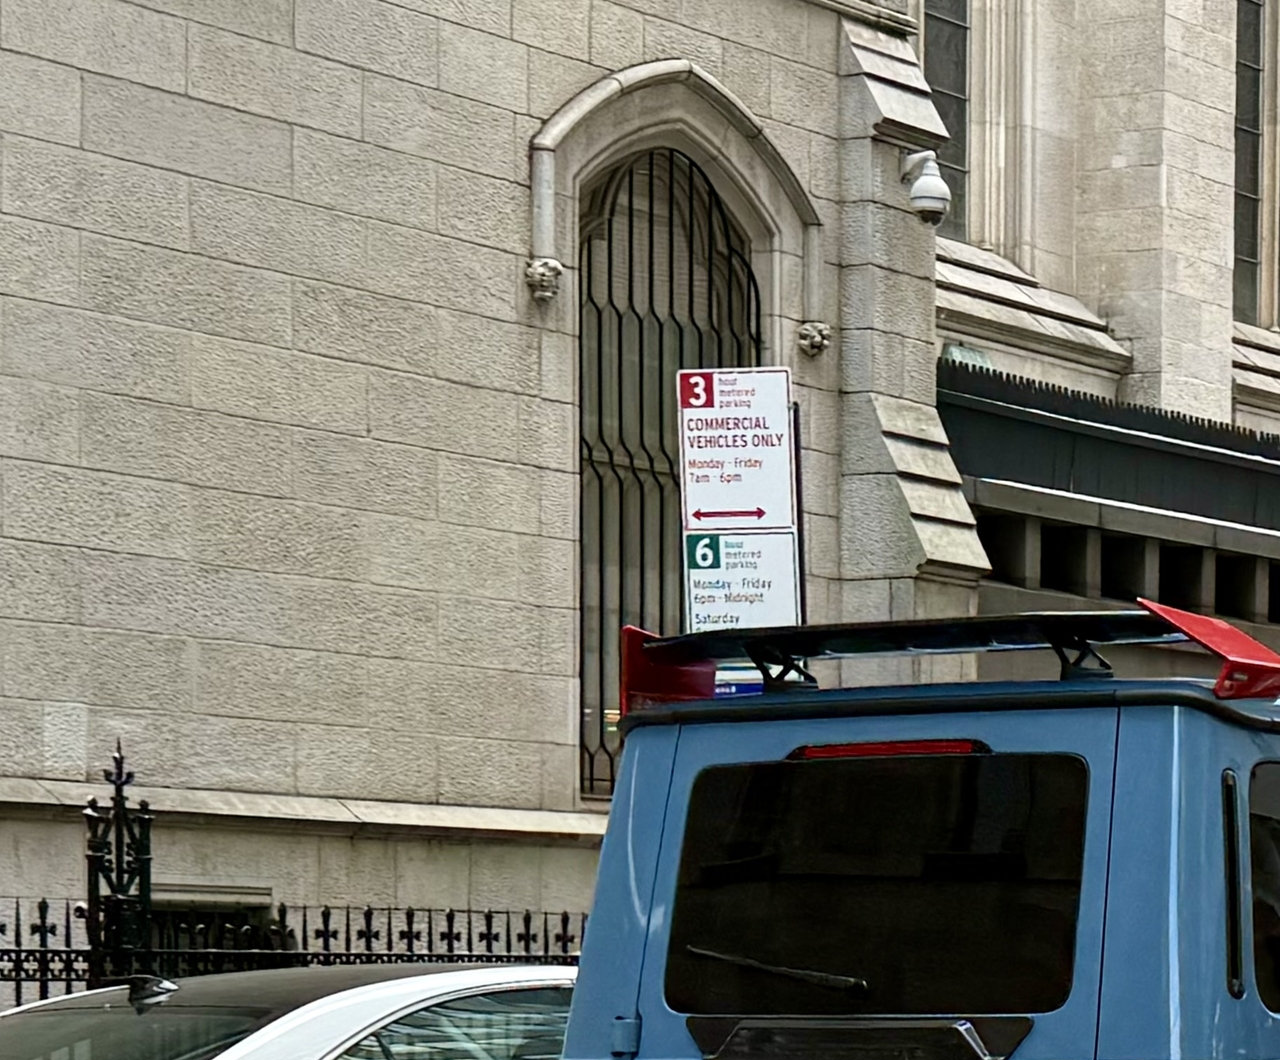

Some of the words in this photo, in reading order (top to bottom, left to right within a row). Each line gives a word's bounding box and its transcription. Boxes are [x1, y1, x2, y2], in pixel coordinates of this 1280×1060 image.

[688, 375, 707, 407] 3
[719, 399, 752, 409] parking
[687, 416, 770, 432] COMMERCIAL
[687, 434, 748, 449] VEHICLES
[752, 433, 784, 448] ONLY
[688, 458, 725, 470] Monday
[734, 457, 763, 470] Friday
[720, 472, 743, 484] 6pm
[695, 537, 714, 568] 6
[693, 579, 732, 591] Monday
[742, 577, 772, 591] Friday
[695, 612, 740, 625] Saturday
